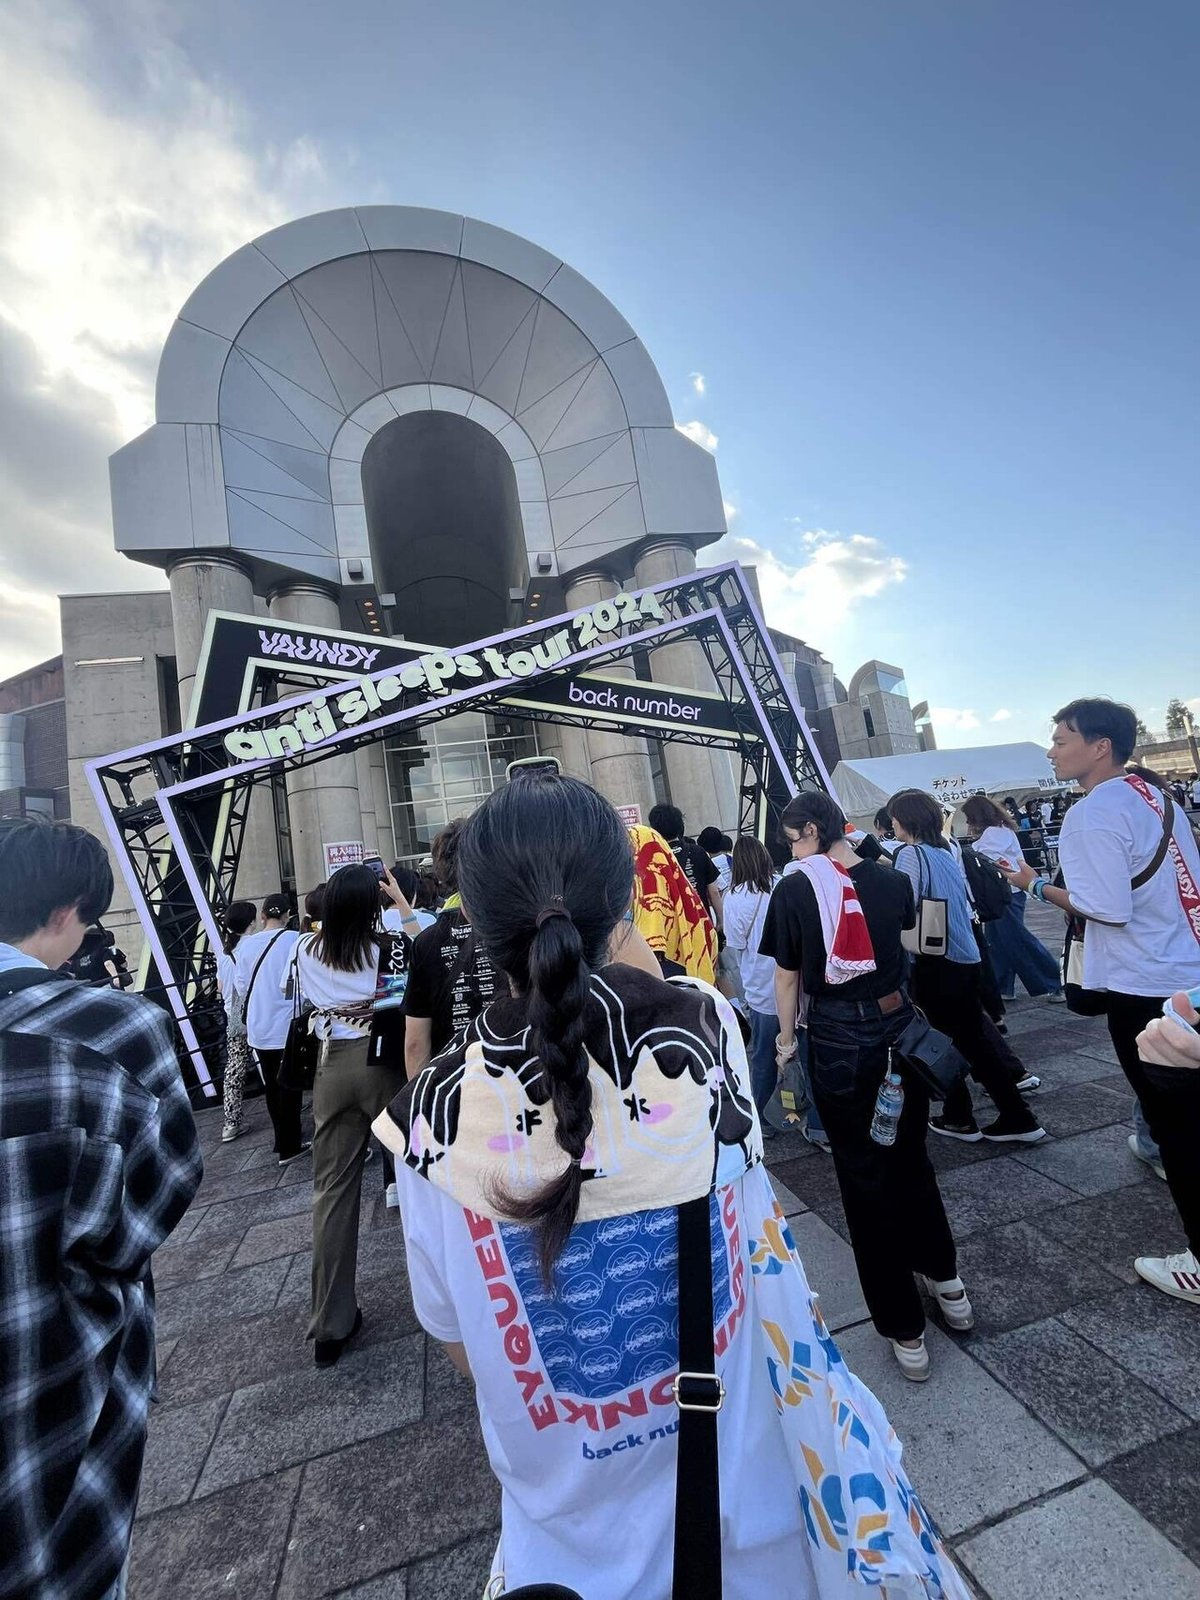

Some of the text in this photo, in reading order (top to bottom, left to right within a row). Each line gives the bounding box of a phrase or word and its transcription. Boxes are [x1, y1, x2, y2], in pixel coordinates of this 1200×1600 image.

[258, 629, 381, 670] VAUNDY
[224, 591, 664, 760] anti sleeps tour 2024
[568, 682, 702, 721] back number
[932, 776, 967, 790] チケット
[463, 1206, 532, 1367] QUEE
[582, 1420, 680, 1460] back nu
